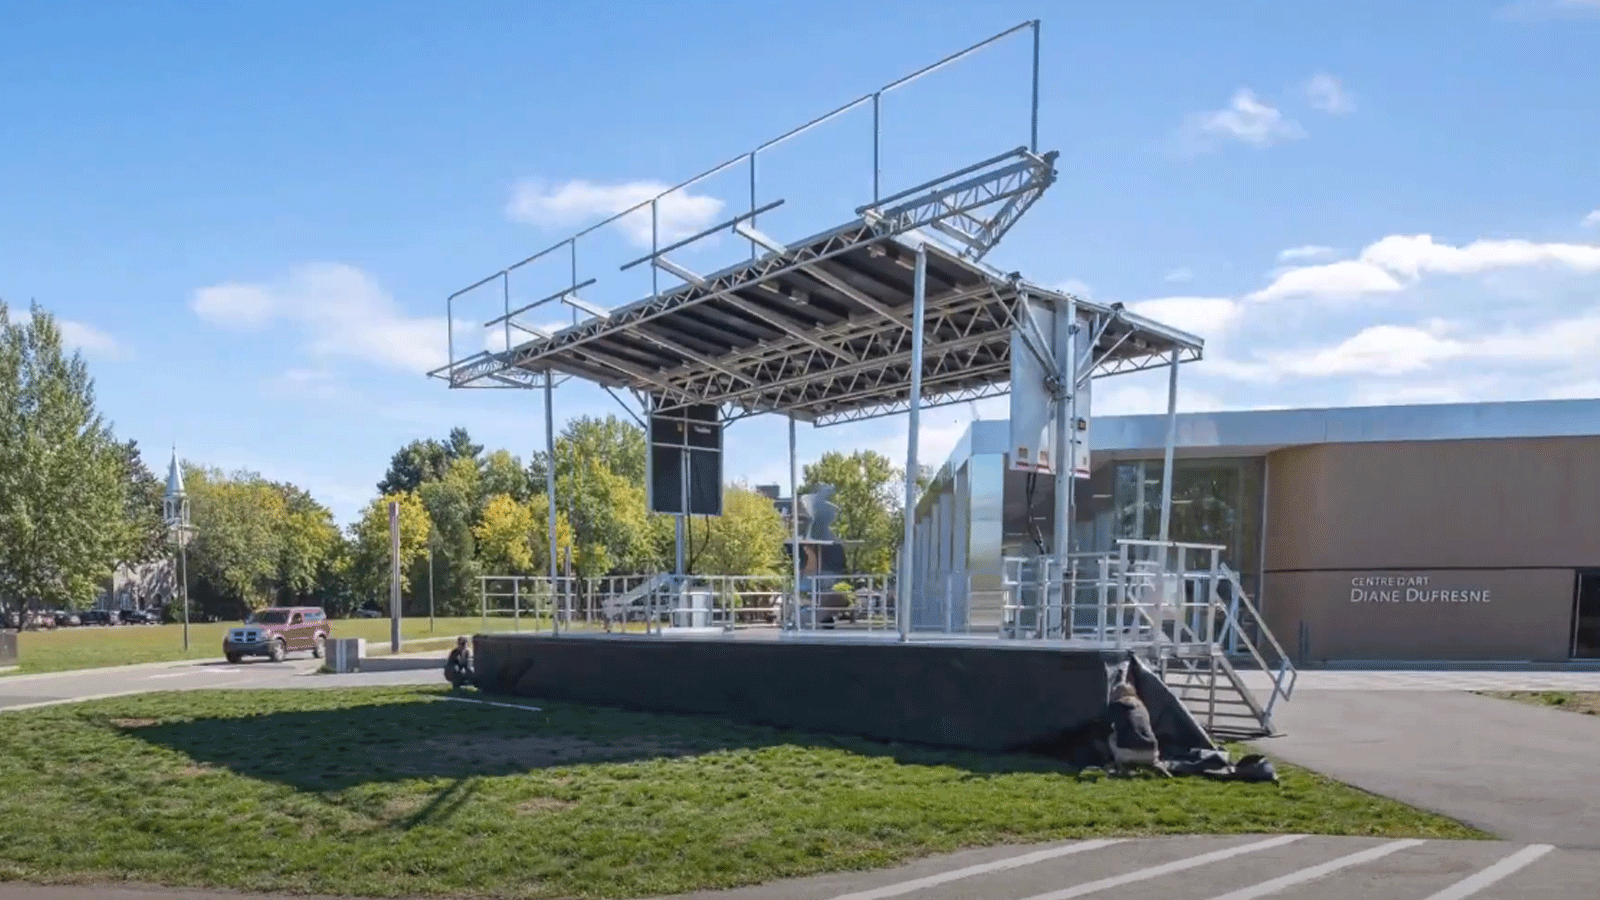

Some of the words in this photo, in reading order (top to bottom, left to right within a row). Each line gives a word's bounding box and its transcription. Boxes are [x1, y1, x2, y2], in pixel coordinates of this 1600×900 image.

[1352, 577, 1394, 586] CENTRE
[1350, 588, 1400, 602] DIANE
[1406, 588, 1491, 603] DUFRESNE
